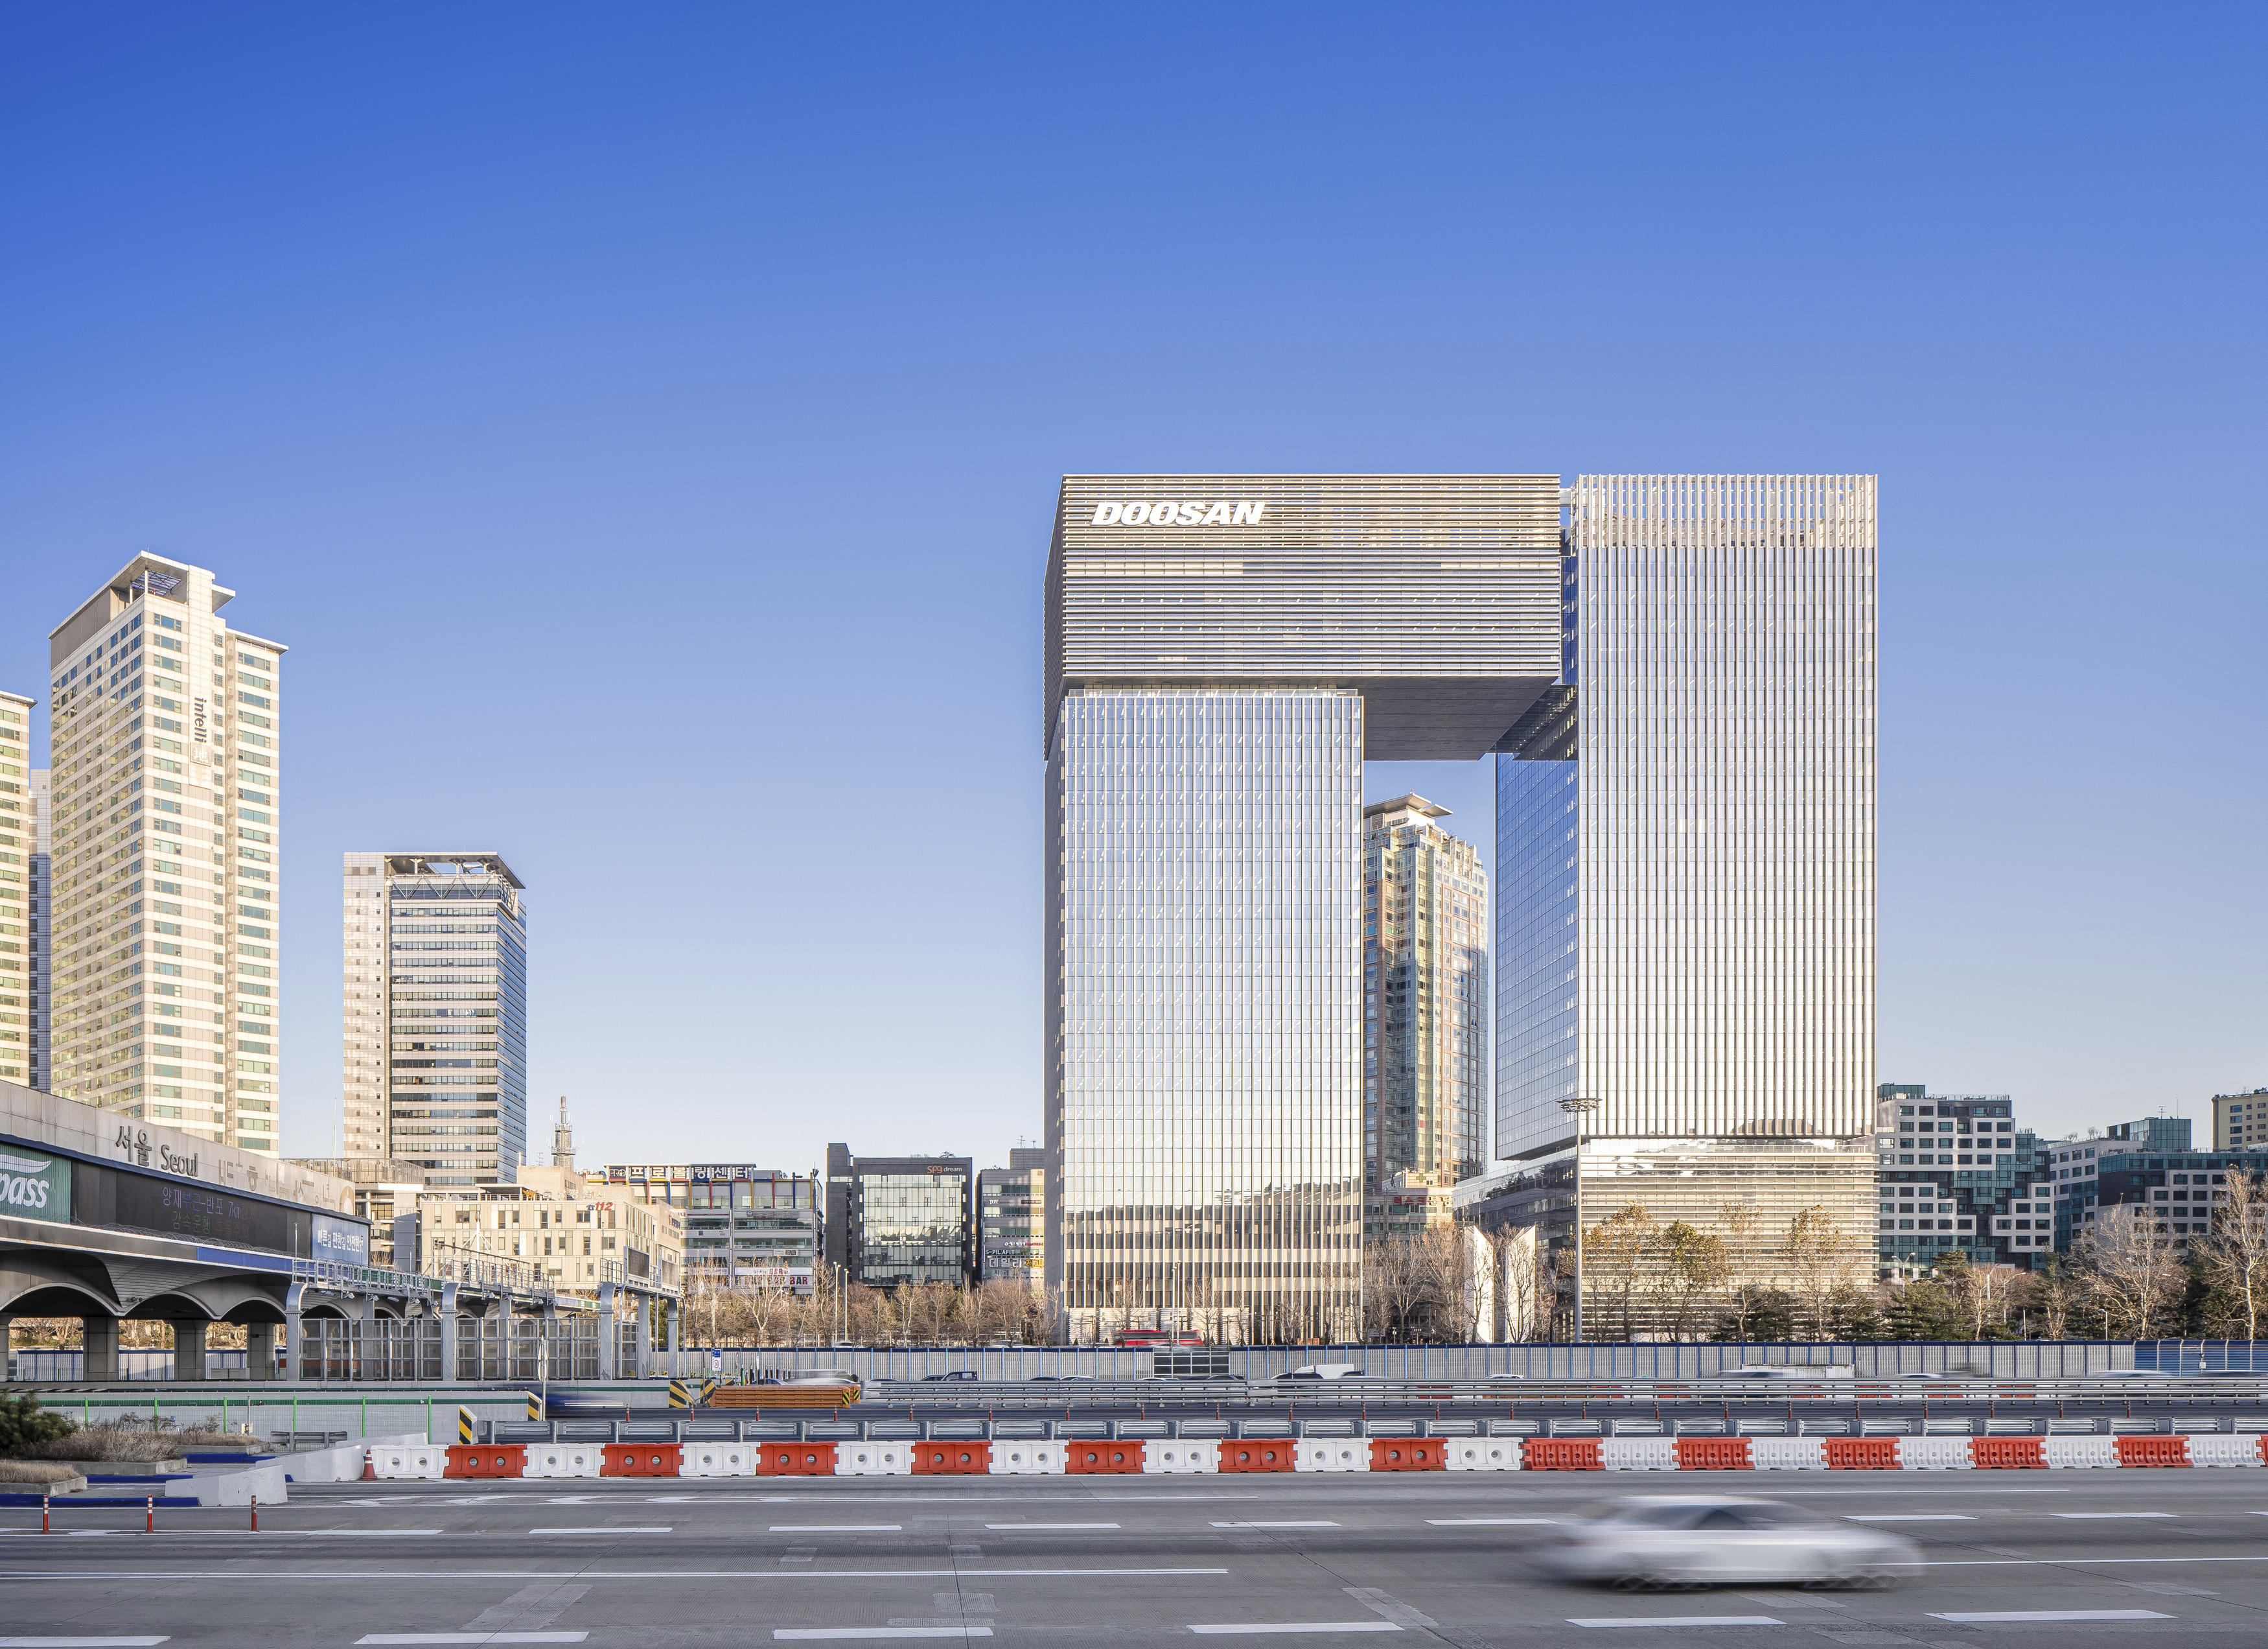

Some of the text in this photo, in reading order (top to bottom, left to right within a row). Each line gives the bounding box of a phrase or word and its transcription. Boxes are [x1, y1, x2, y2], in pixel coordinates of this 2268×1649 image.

[1091, 501, 1266, 526] DOOSAN
[194, 697, 207, 743] intelli
[115, 1125, 152, 1167] 서울
[161, 1144, 198, 1177] Seoul
[163, 1187, 224, 1215] 양재부근-반포
[596, 1202, 613, 1211] 112
[172, 1211, 211, 1235] 감속운행
[332, 1232, 346, 1250] 편한길
[789, 1276, 808, 1285] BAR
